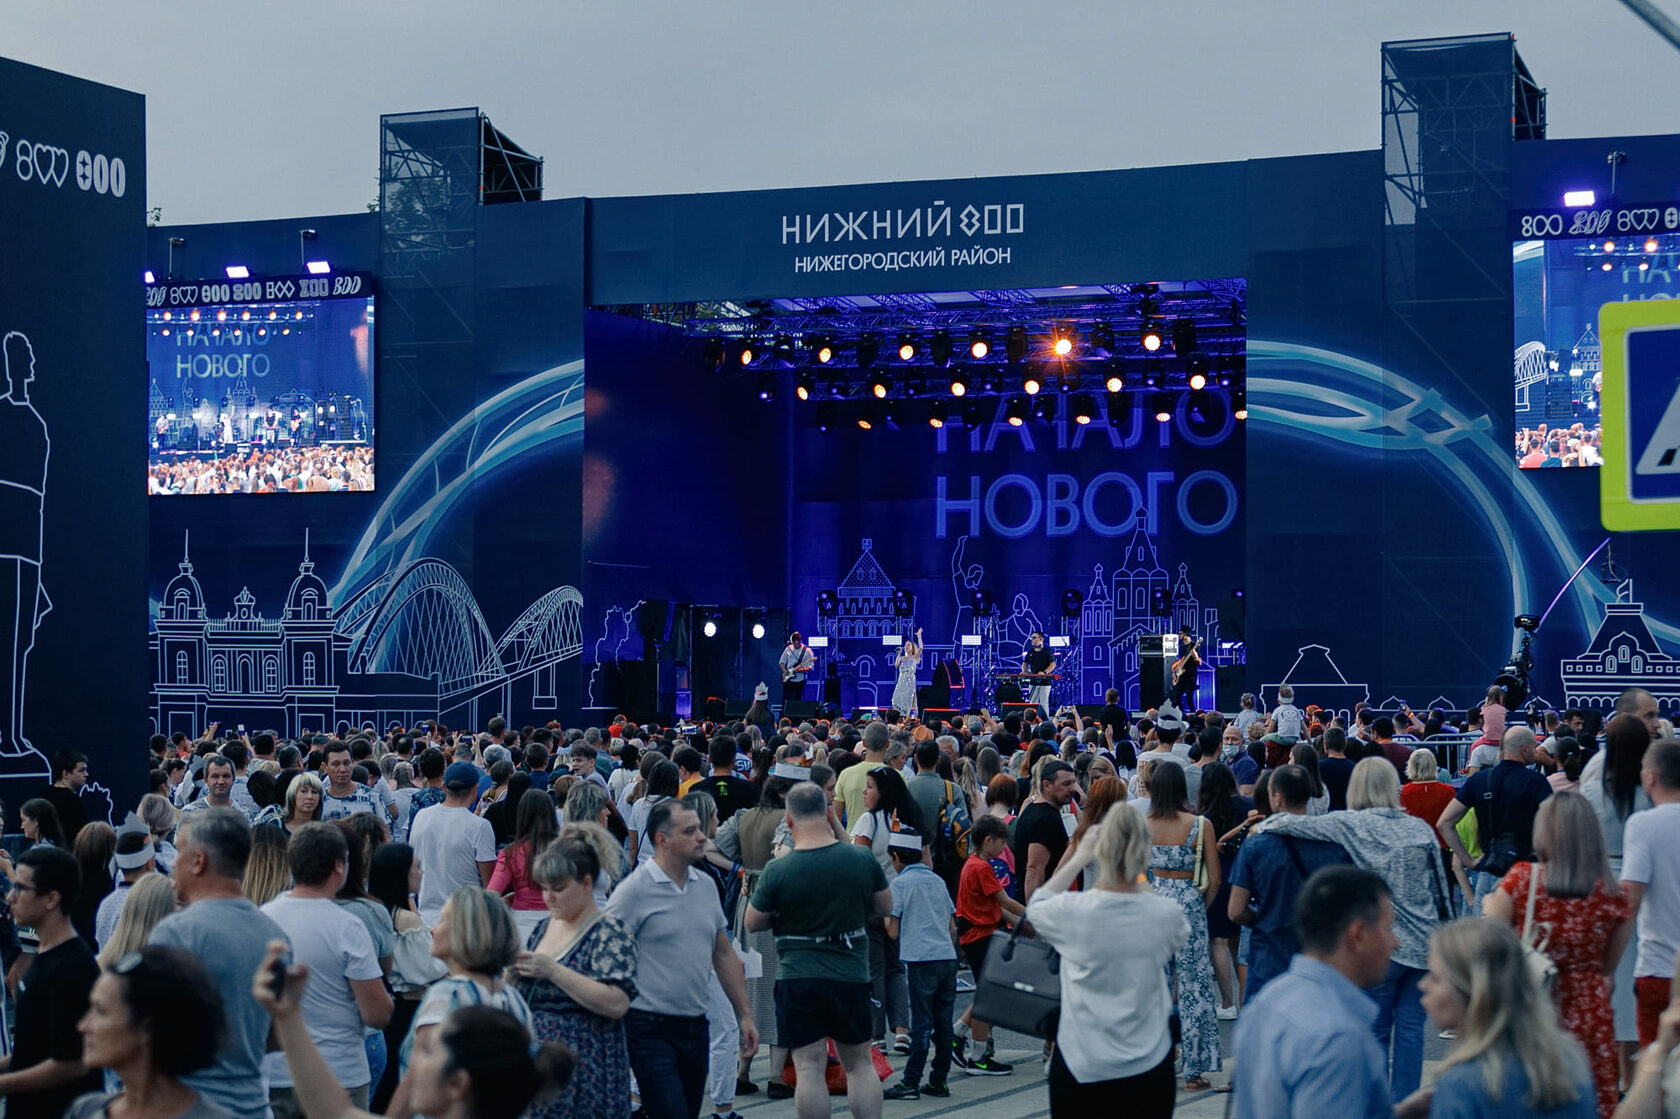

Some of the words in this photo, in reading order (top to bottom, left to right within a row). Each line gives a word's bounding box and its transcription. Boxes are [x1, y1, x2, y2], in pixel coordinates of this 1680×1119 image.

[782, 200, 951, 245] НИЖНИЙ
[1521, 215, 1563, 237] 800
[795, 246, 946, 273] НИЖЕГОРОДСКИЙ
[951, 245, 1011, 266] РАЙОН
[176, 353, 271, 379] НОВОГО
[935, 470, 1239, 537] НОВОГО
